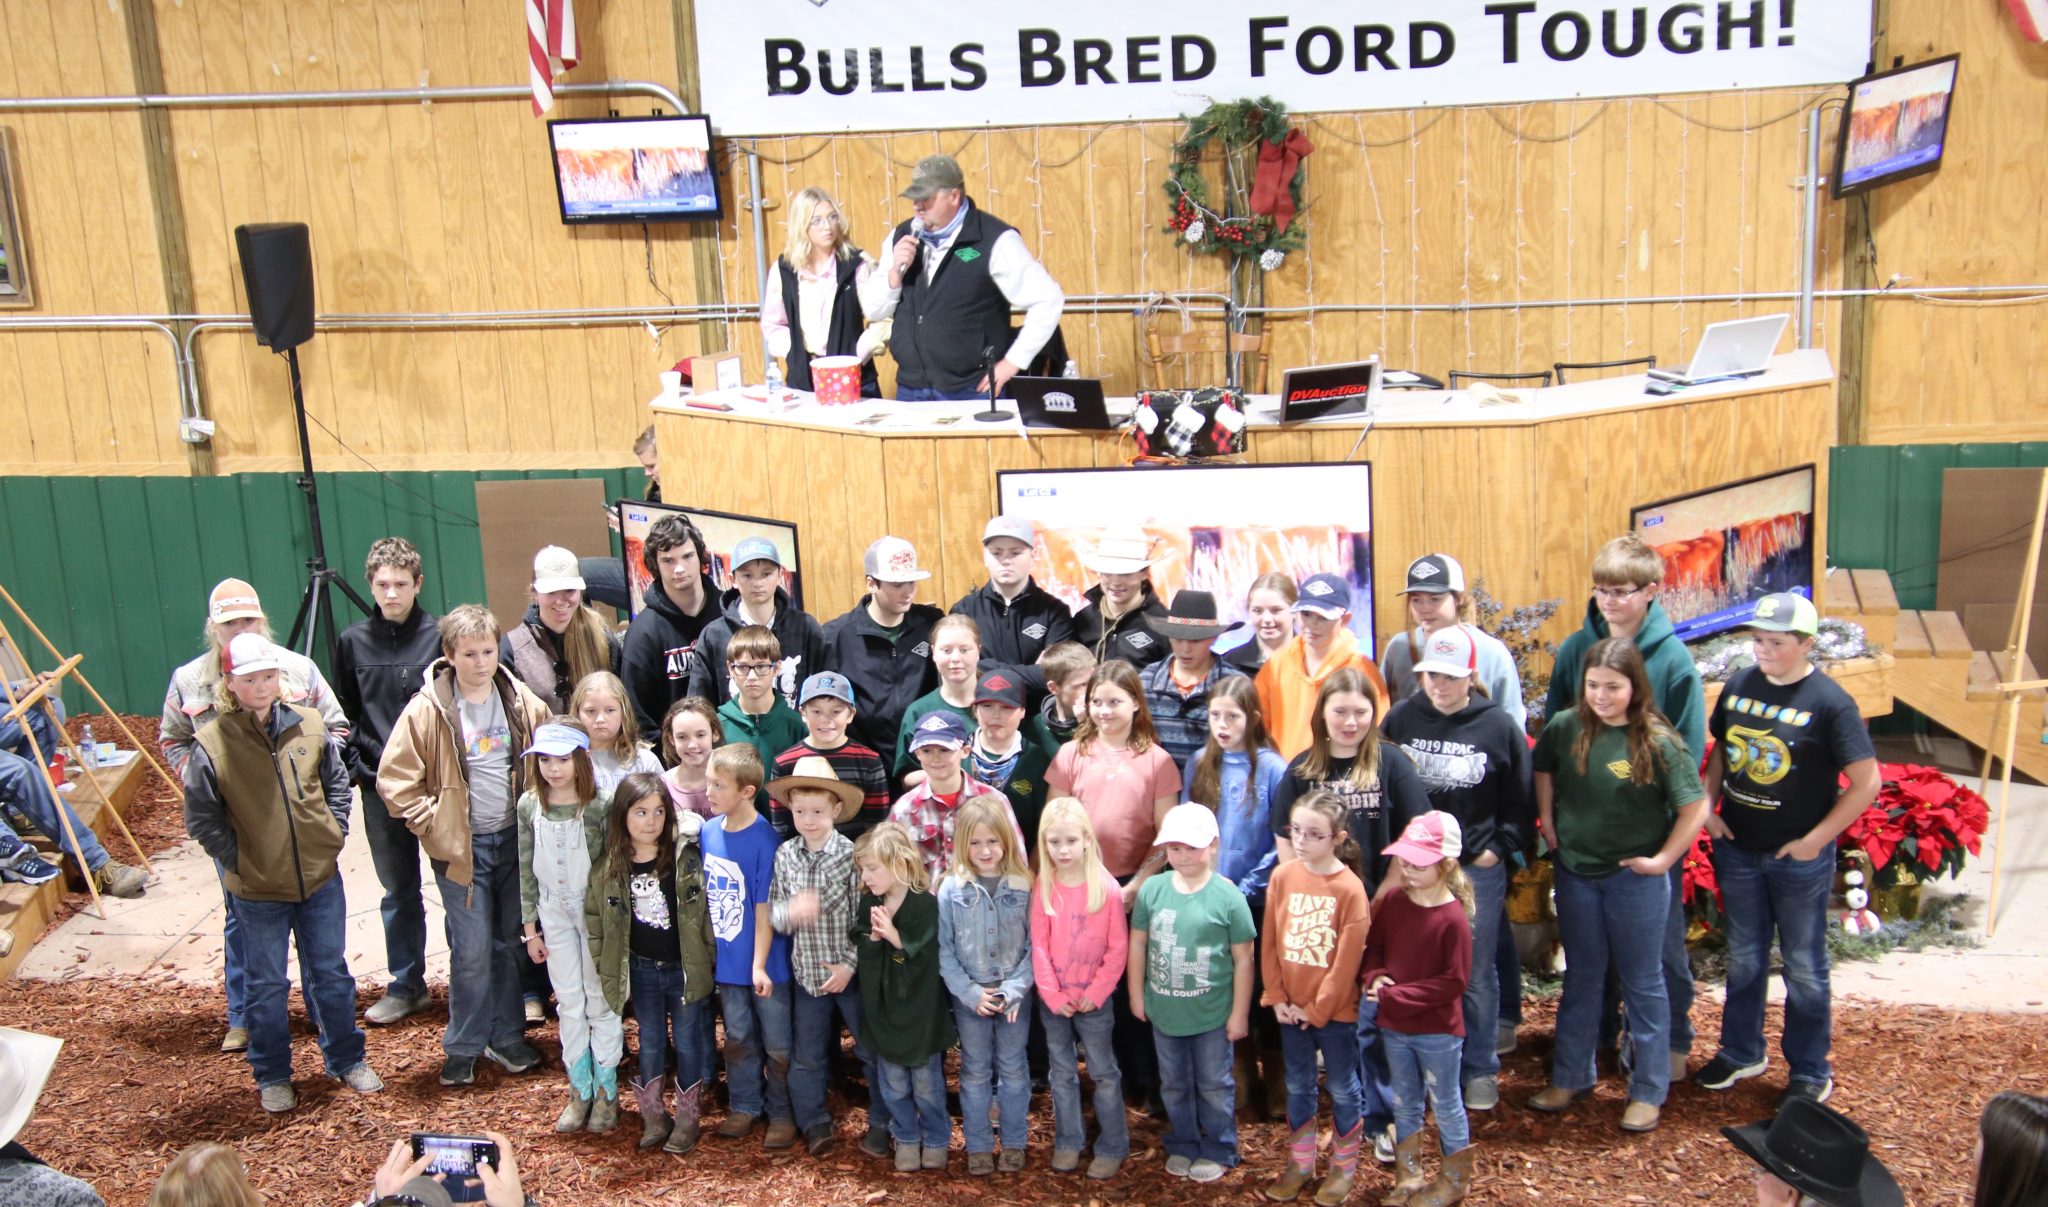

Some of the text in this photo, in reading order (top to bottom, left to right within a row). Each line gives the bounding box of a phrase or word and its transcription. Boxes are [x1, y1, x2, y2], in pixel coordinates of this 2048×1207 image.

[764, 0, 1797, 97] BULLS BRED FORD TOUGH!
[1289, 384, 1367, 401] DVAuction
[1411, 738, 1476, 755] 2019 RPAC
[1287, 893, 1338, 916] HAVE
[1289, 909, 1332, 935] THE
[1284, 926, 1338, 950] BEST
[1283, 946, 1333, 968] DAY
[1172, 986, 1211, 997] COUNTY
